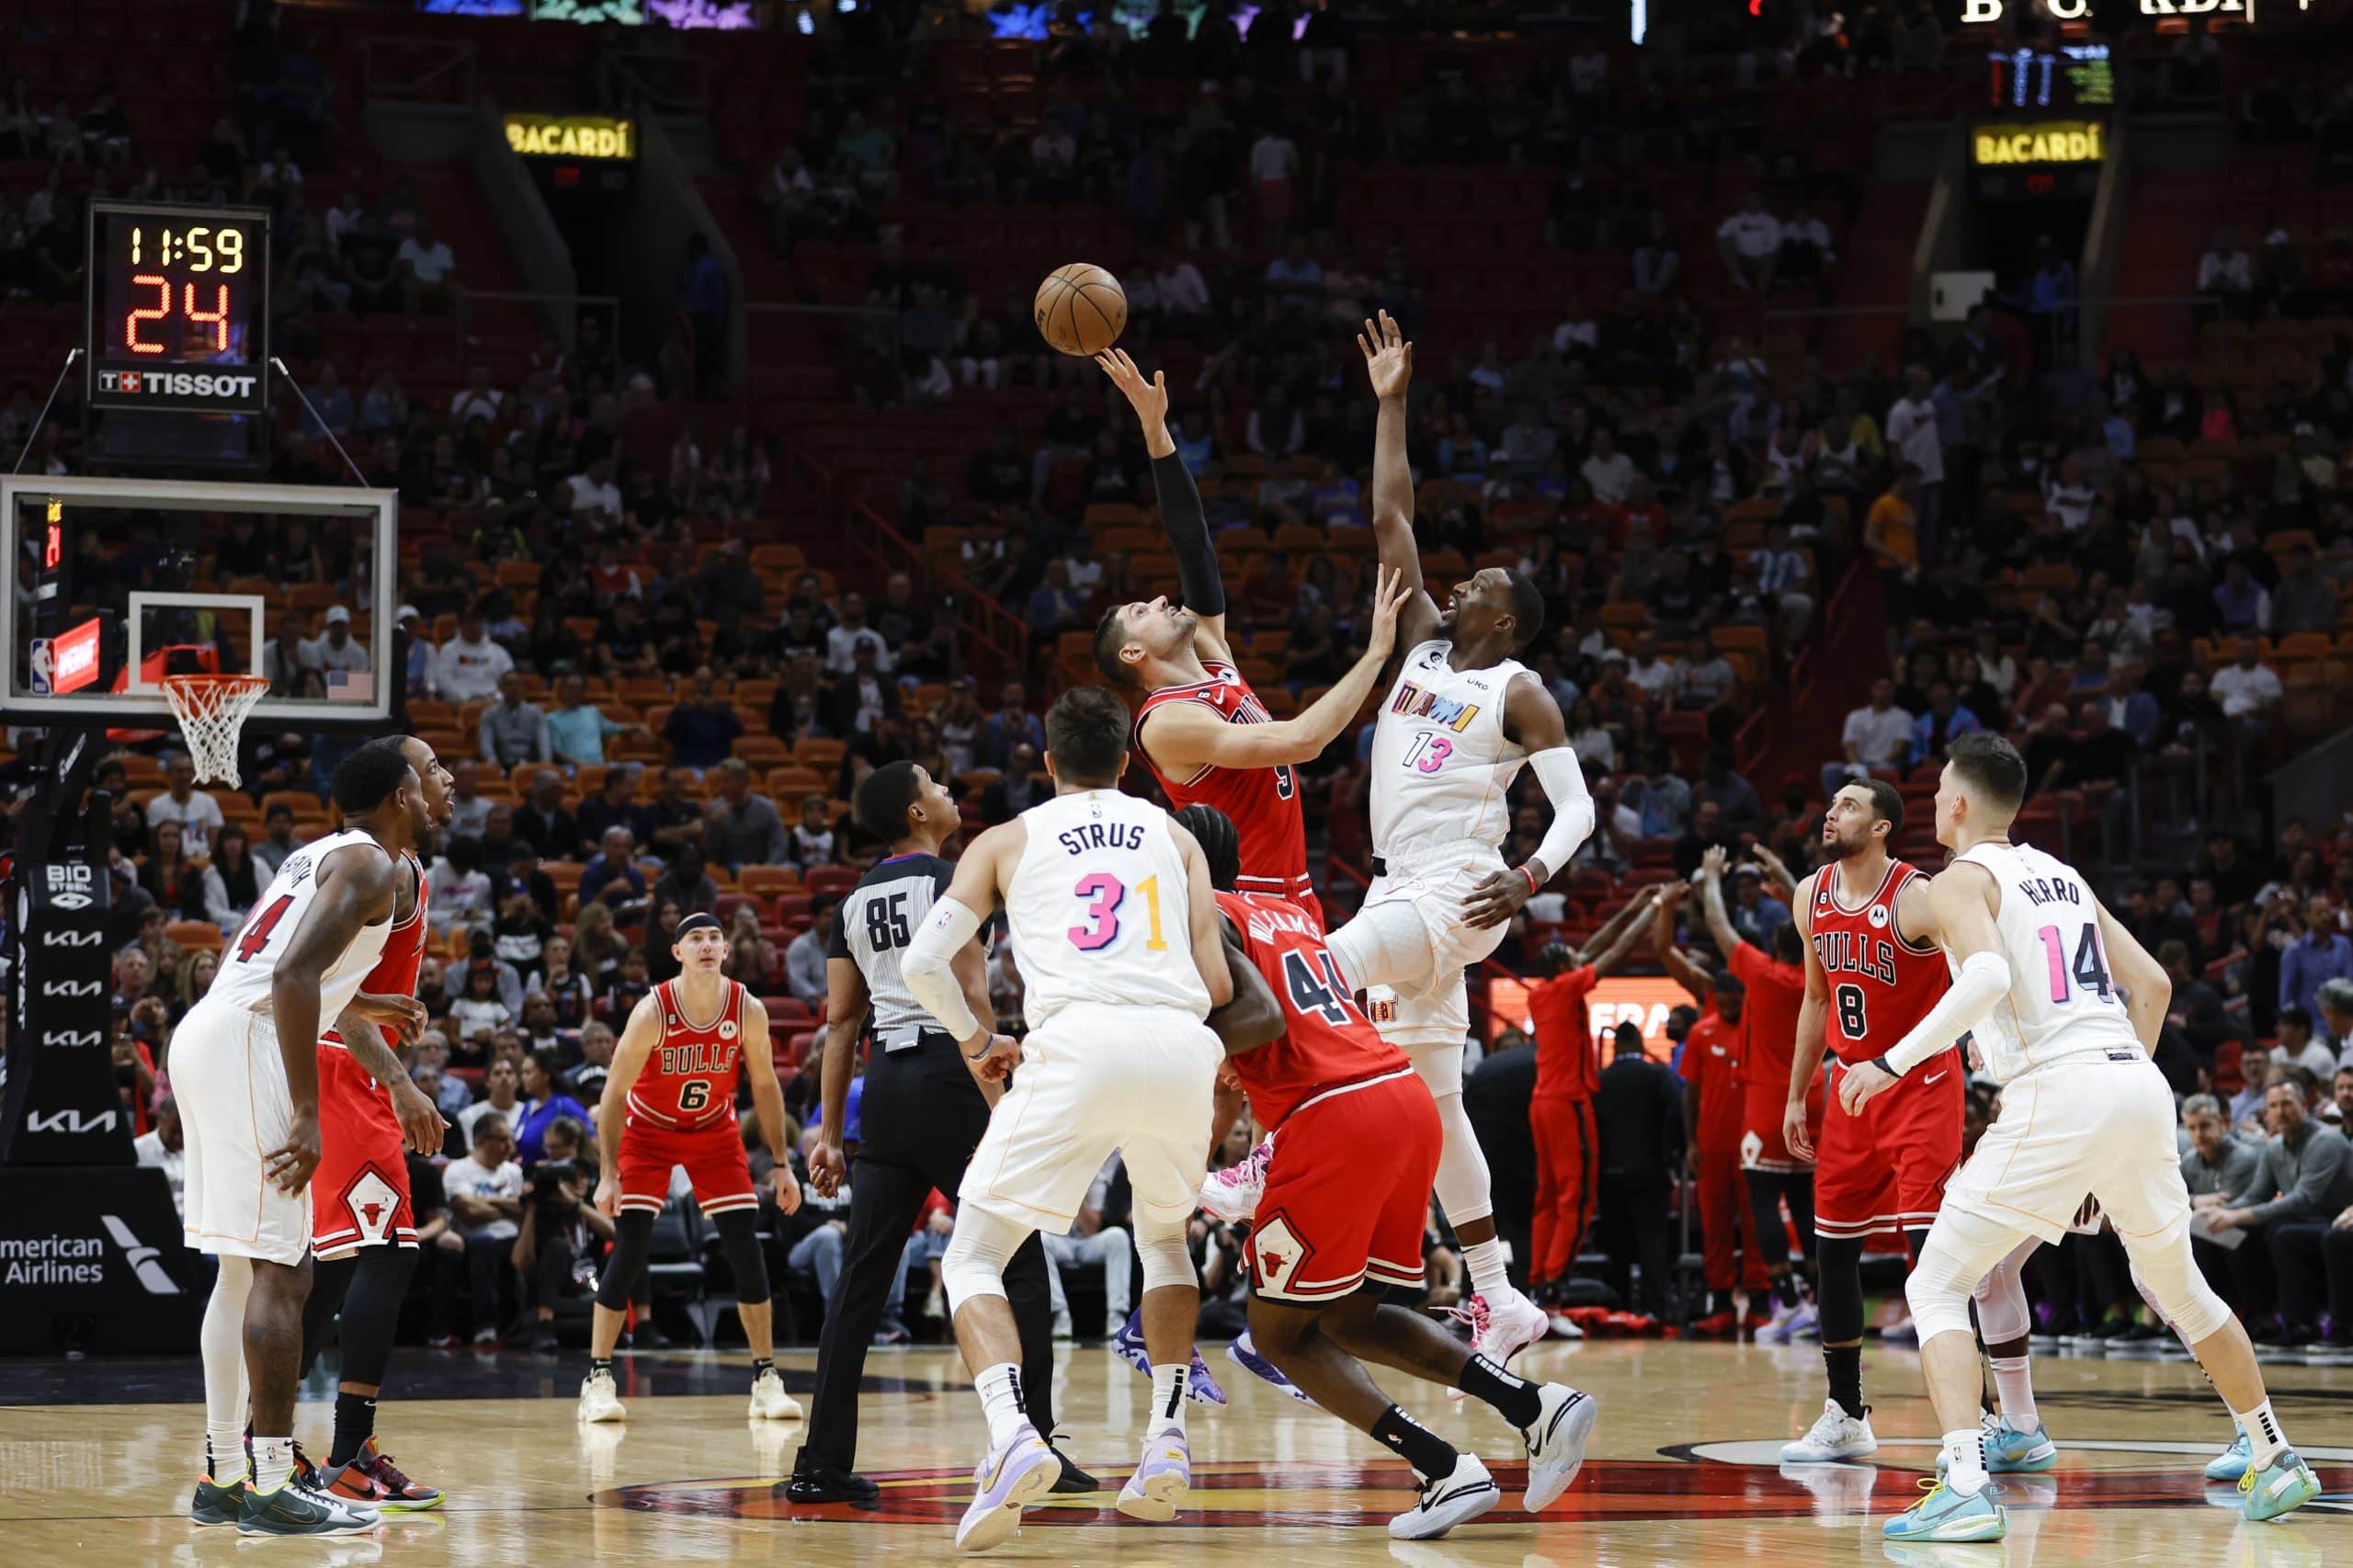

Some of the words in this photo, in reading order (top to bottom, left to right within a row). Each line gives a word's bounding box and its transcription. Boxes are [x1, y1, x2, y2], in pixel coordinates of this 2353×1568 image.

[1977, 124, 2099, 164] BACARDÍ
[132, 228, 243, 273] 11:59
[127, 275, 228, 353] 24
[142, 372, 256, 398] TISSOT
[1467, 677, 1489, 690] UKG
[1403, 733, 1453, 773] 13
[1059, 823, 1144, 856] STRUS
[46, 866, 92, 882] BIO
[47, 881, 92, 892] STEEL
[1067, 872, 1168, 951] 31
[1819, 892, 1827, 904] 6
[866, 892, 911, 952] 85
[2038, 922, 2115, 1004] 14
[1836, 983, 1868, 1040] 8
[677, 1079, 711, 1112] 6
[5, 1259, 103, 1284] Airlines
